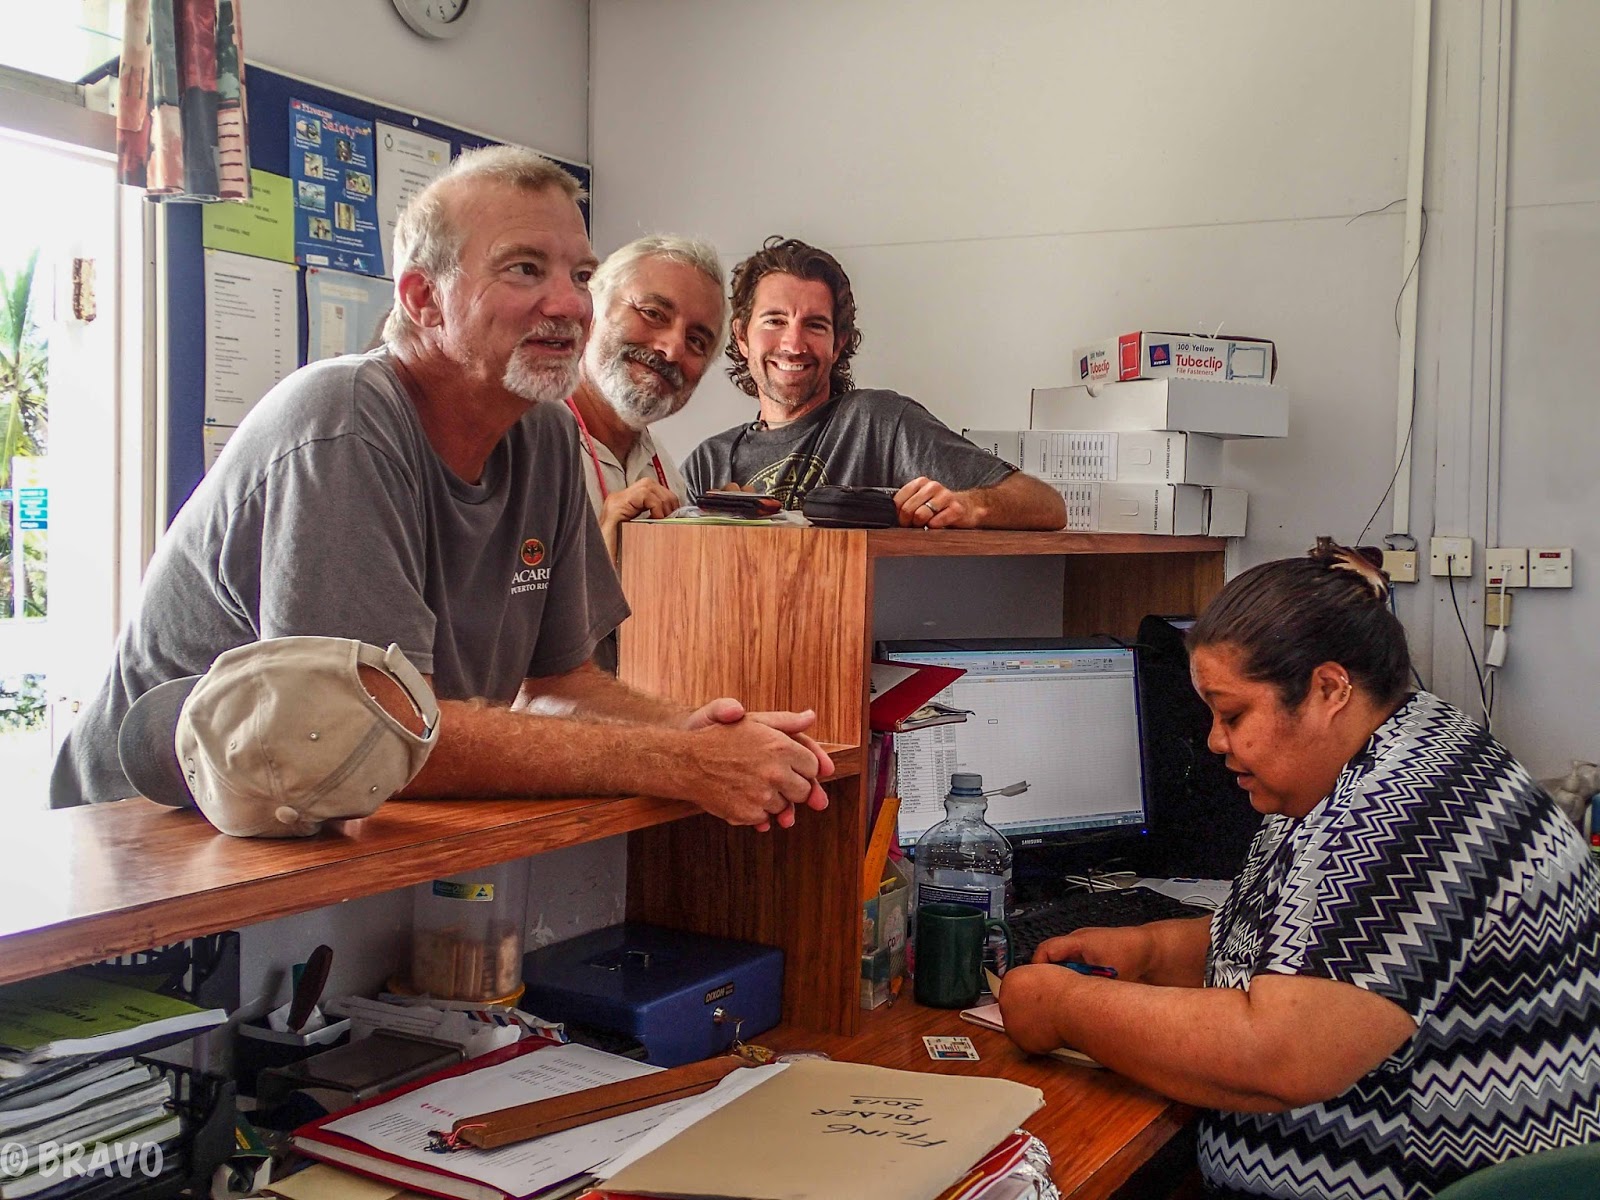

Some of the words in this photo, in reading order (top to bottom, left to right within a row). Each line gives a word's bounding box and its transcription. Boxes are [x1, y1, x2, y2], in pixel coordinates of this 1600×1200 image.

[322, 117, 356, 140] Safety
[1177, 343, 1190, 351] 100
[1192, 344, 1215, 353] Yellow
[1090, 359, 1110, 375] Tubeclip
[1175, 354, 1223, 372] Tubeclip
[1187, 368, 1214, 376] Fasteners
[511, 568, 551, 584] ACAR
[511, 583, 536, 594] PUERTO
[1021, 838, 1043, 846] SAMSUNG
[705, 987, 725, 1003] DIXON
[850, 1099, 923, 1110] 2013
[811, 1108, 932, 1126] FOLDER
[822, 1124, 947, 1148] FILING
